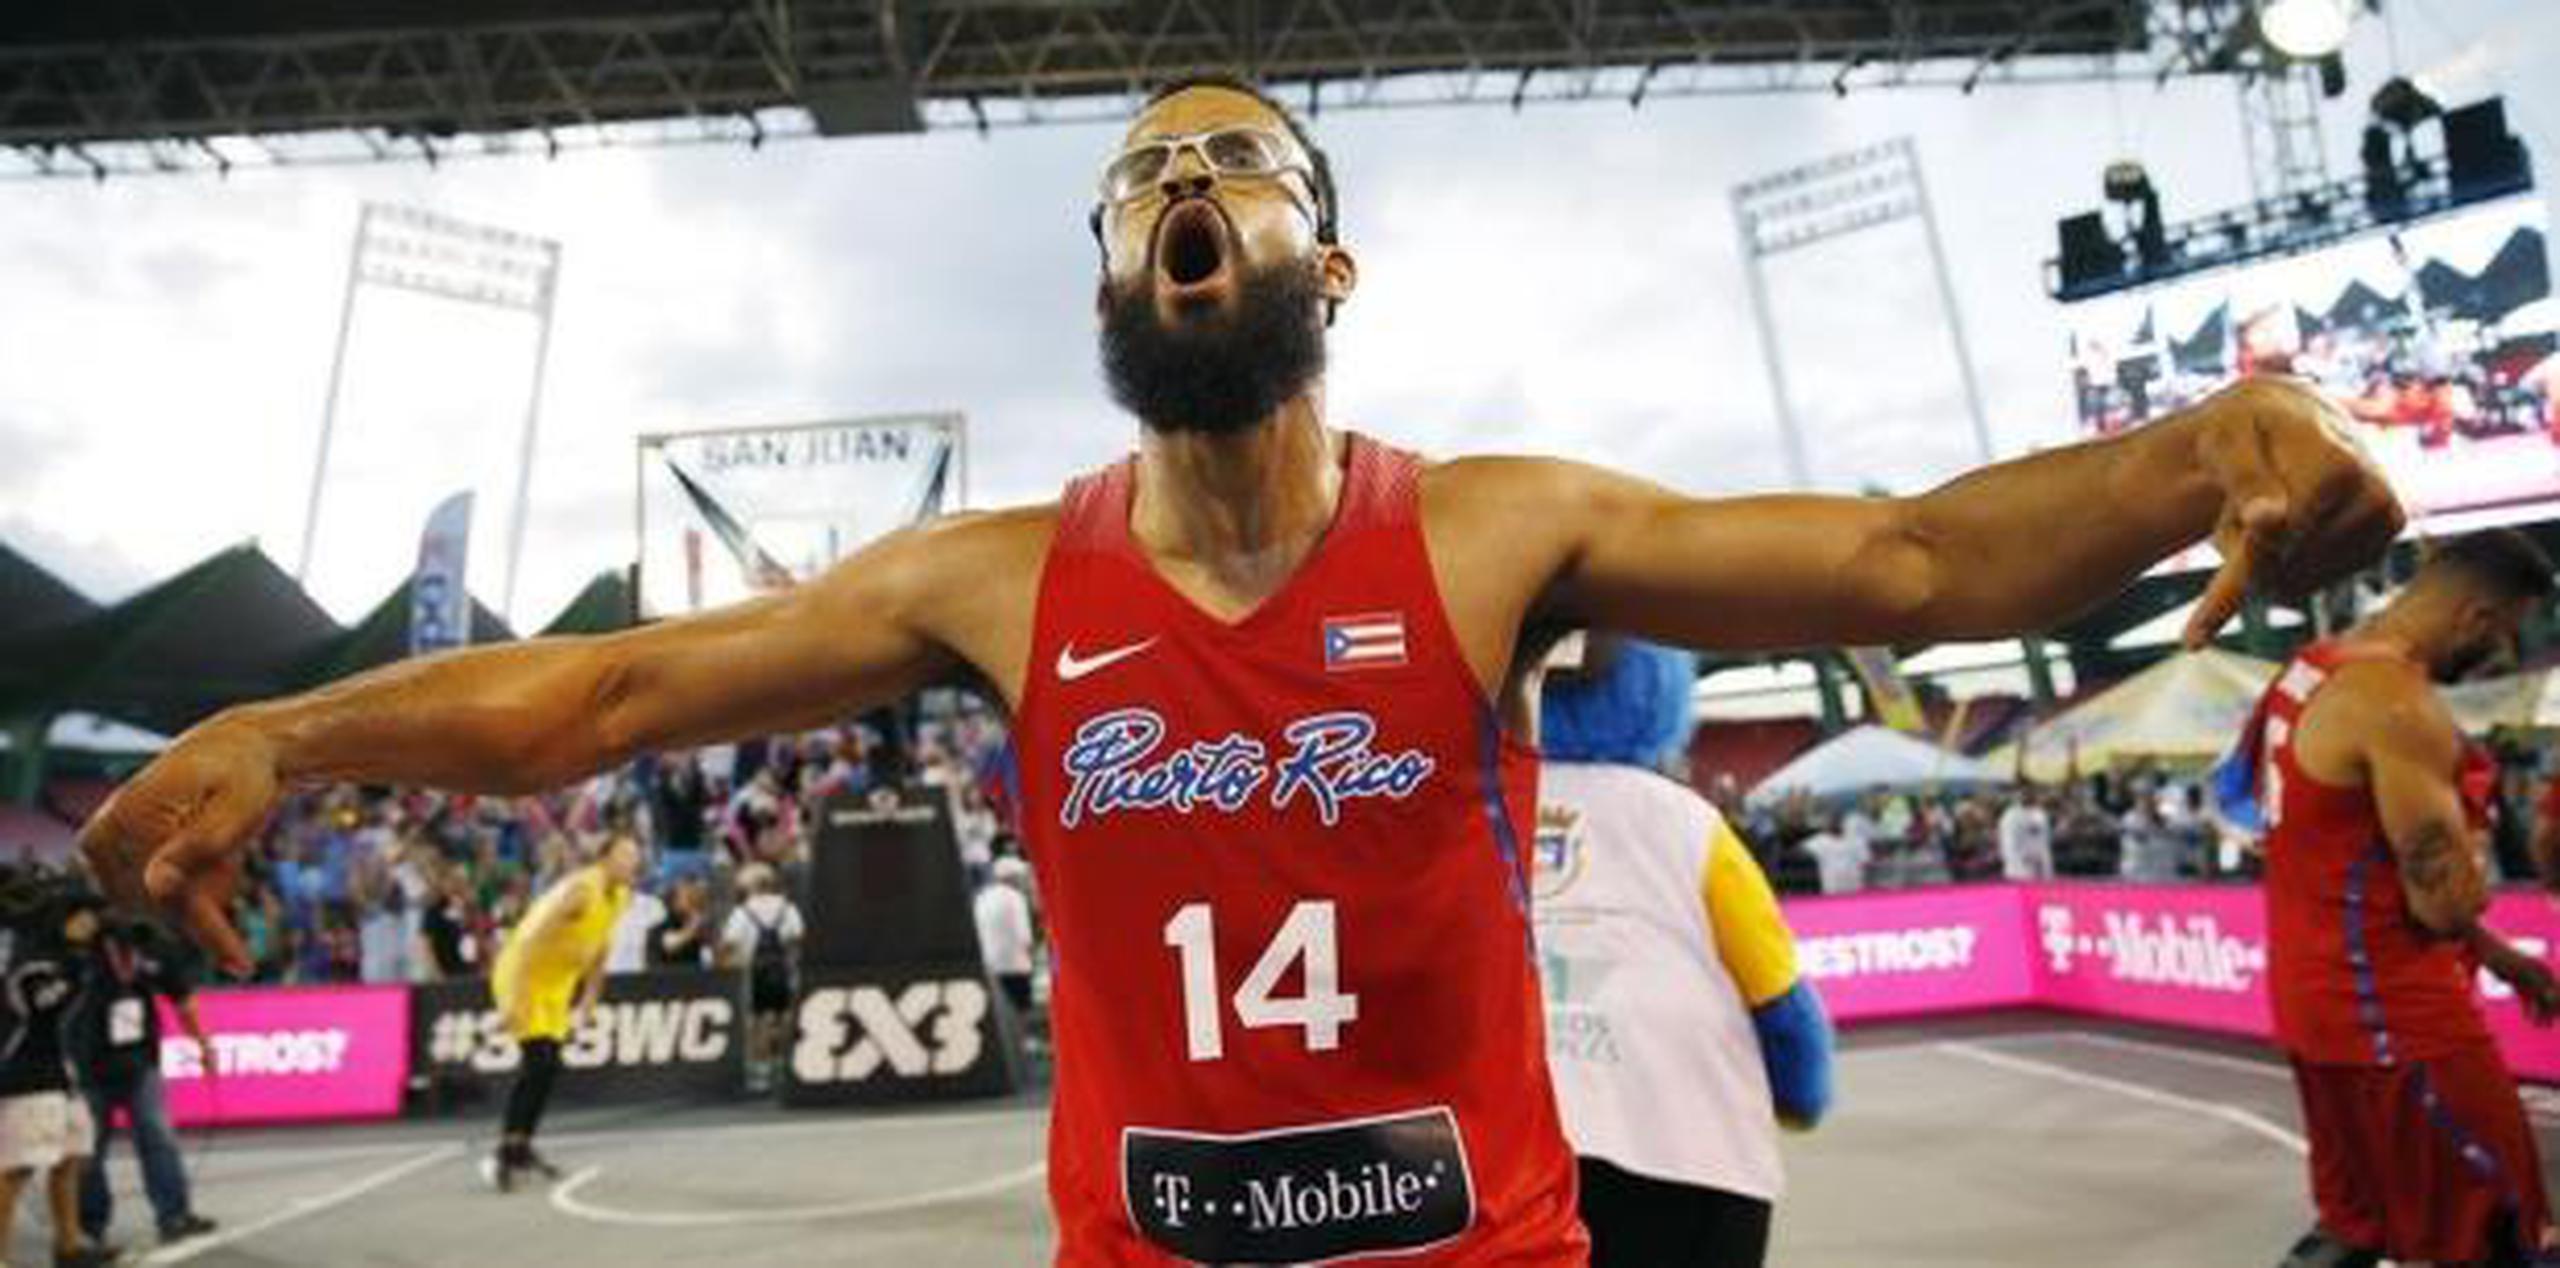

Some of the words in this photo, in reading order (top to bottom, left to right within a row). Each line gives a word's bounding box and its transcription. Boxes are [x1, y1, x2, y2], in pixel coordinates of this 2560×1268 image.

[701, 432, 790, 473] SAN
[801, 428, 912, 466] JUAN
[1060, 707, 1268, 828] Puerto
[1271, 711, 1434, 826] Rico
[1163, 900, 1359, 1061] 14
